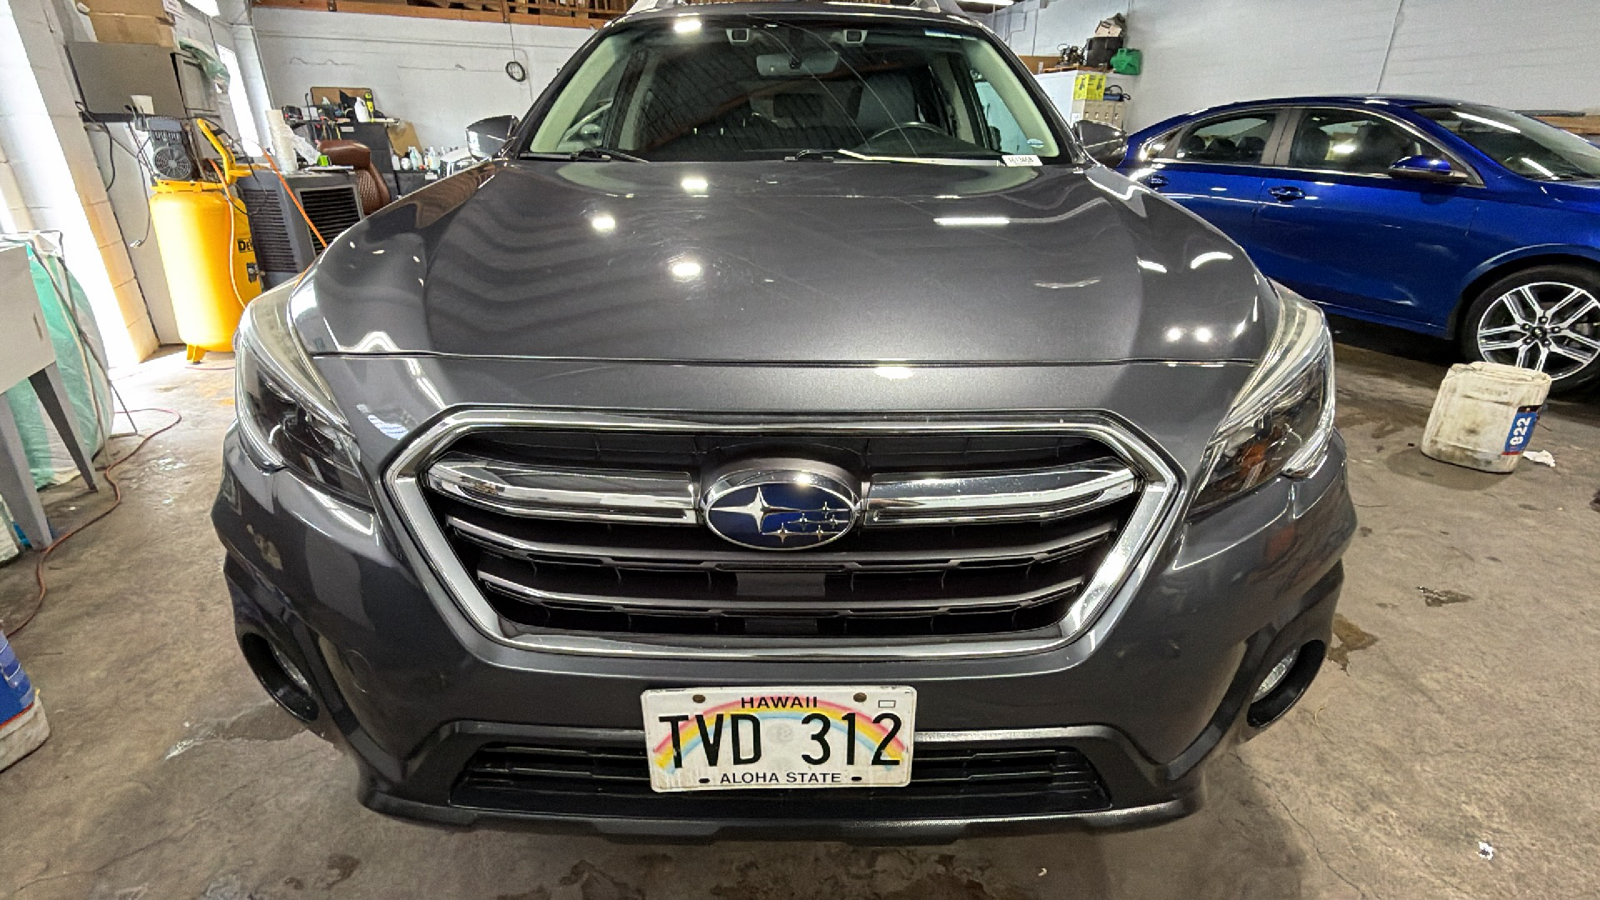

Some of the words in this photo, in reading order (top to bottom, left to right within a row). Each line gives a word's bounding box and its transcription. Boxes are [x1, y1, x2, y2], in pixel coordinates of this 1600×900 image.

[741, 696, 818, 709] HAWAII
[659, 713, 762, 769] TVD
[801, 712, 902, 766] 312
[720, 773, 780, 784] ALOHA
[786, 772, 842, 784] STATE
